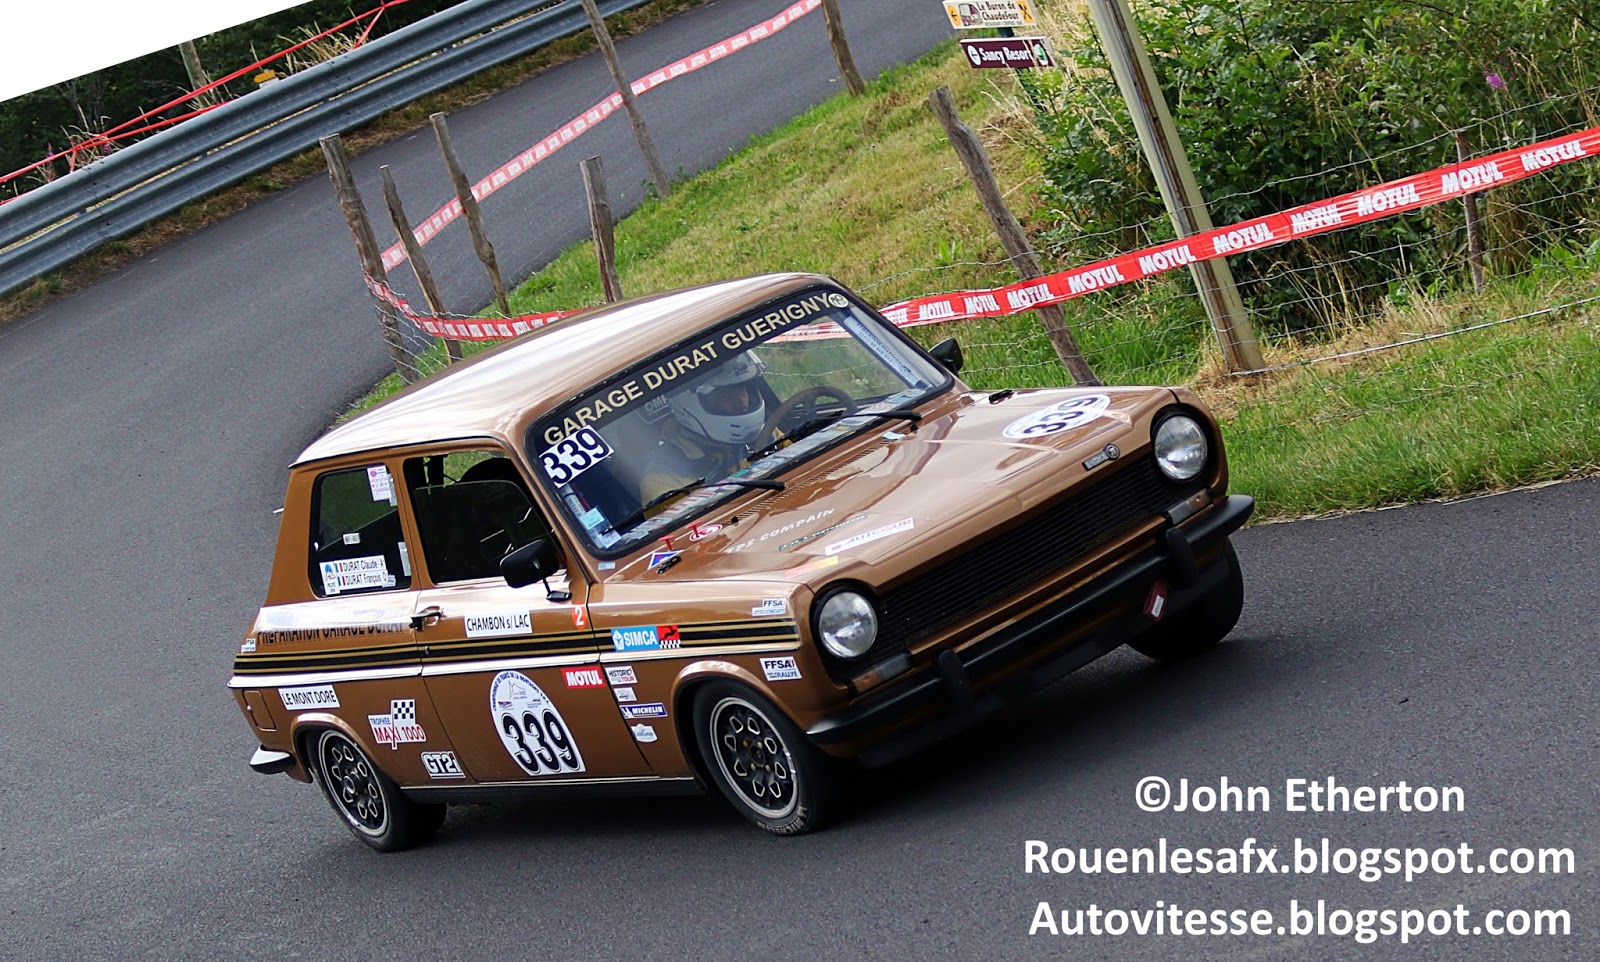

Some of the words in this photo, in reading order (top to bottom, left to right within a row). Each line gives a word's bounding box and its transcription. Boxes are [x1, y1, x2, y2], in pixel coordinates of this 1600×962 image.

[977, 2, 986, 11] Le
[987, 1, 1007, 11] Buron
[1007, 1, 1016, 10] de
[982, 11, 1019, 21] Chaudefour
[979, 47, 1006, 65] Sancy
[1002, 46, 1032, 61] Resort
[964, 294, 999, 315] MOTUL
[1006, 283, 1054, 309] MOTUL
[1068, 265, 1124, 294] MOTUL
[1139, 245, 1197, 275] MOTUL
[1212, 222, 1274, 254] MOTUL
[1358, 183, 1421, 217] MOTUL
[1441, 162, 1505, 195] MOTUL
[1520, 140, 1587, 172] MOTUL
[544, 380, 643, 445] GARAGE
[643, 341, 718, 390] DURAT
[722, 292, 830, 350] GUERIGNY
[1023, 397, 1099, 434] 339
[540, 428, 610, 485] 339
[760, 508, 835, 541] COMPAIN
[846, 517, 913, 545] AUTOSUR
[343, 560, 361, 572] DURAT
[361, 559, 378, 570] Claude
[345, 573, 363, 585] DURAT
[363, 572, 381, 585] François
[764, 599, 783, 607] FFSA
[466, 615, 505, 632] CHAMBON
[514, 614, 530, 628] LAC
[574, 606, 585, 626] 2
[623, 630, 658, 647] SIMCA
[764, 659, 792, 670] FFSA
[565, 669, 603, 687] MOTUL
[777, 670, 798, 678] RALLYE
[281, 692, 294, 705] LE
[291, 691, 315, 705] MONT
[313, 689, 337, 703] DORE
[632, 705, 663, 715] MICHELIN
[373, 726, 402, 742] MAXI
[401, 725, 426, 741] 1000
[501, 708, 581, 775] 339
